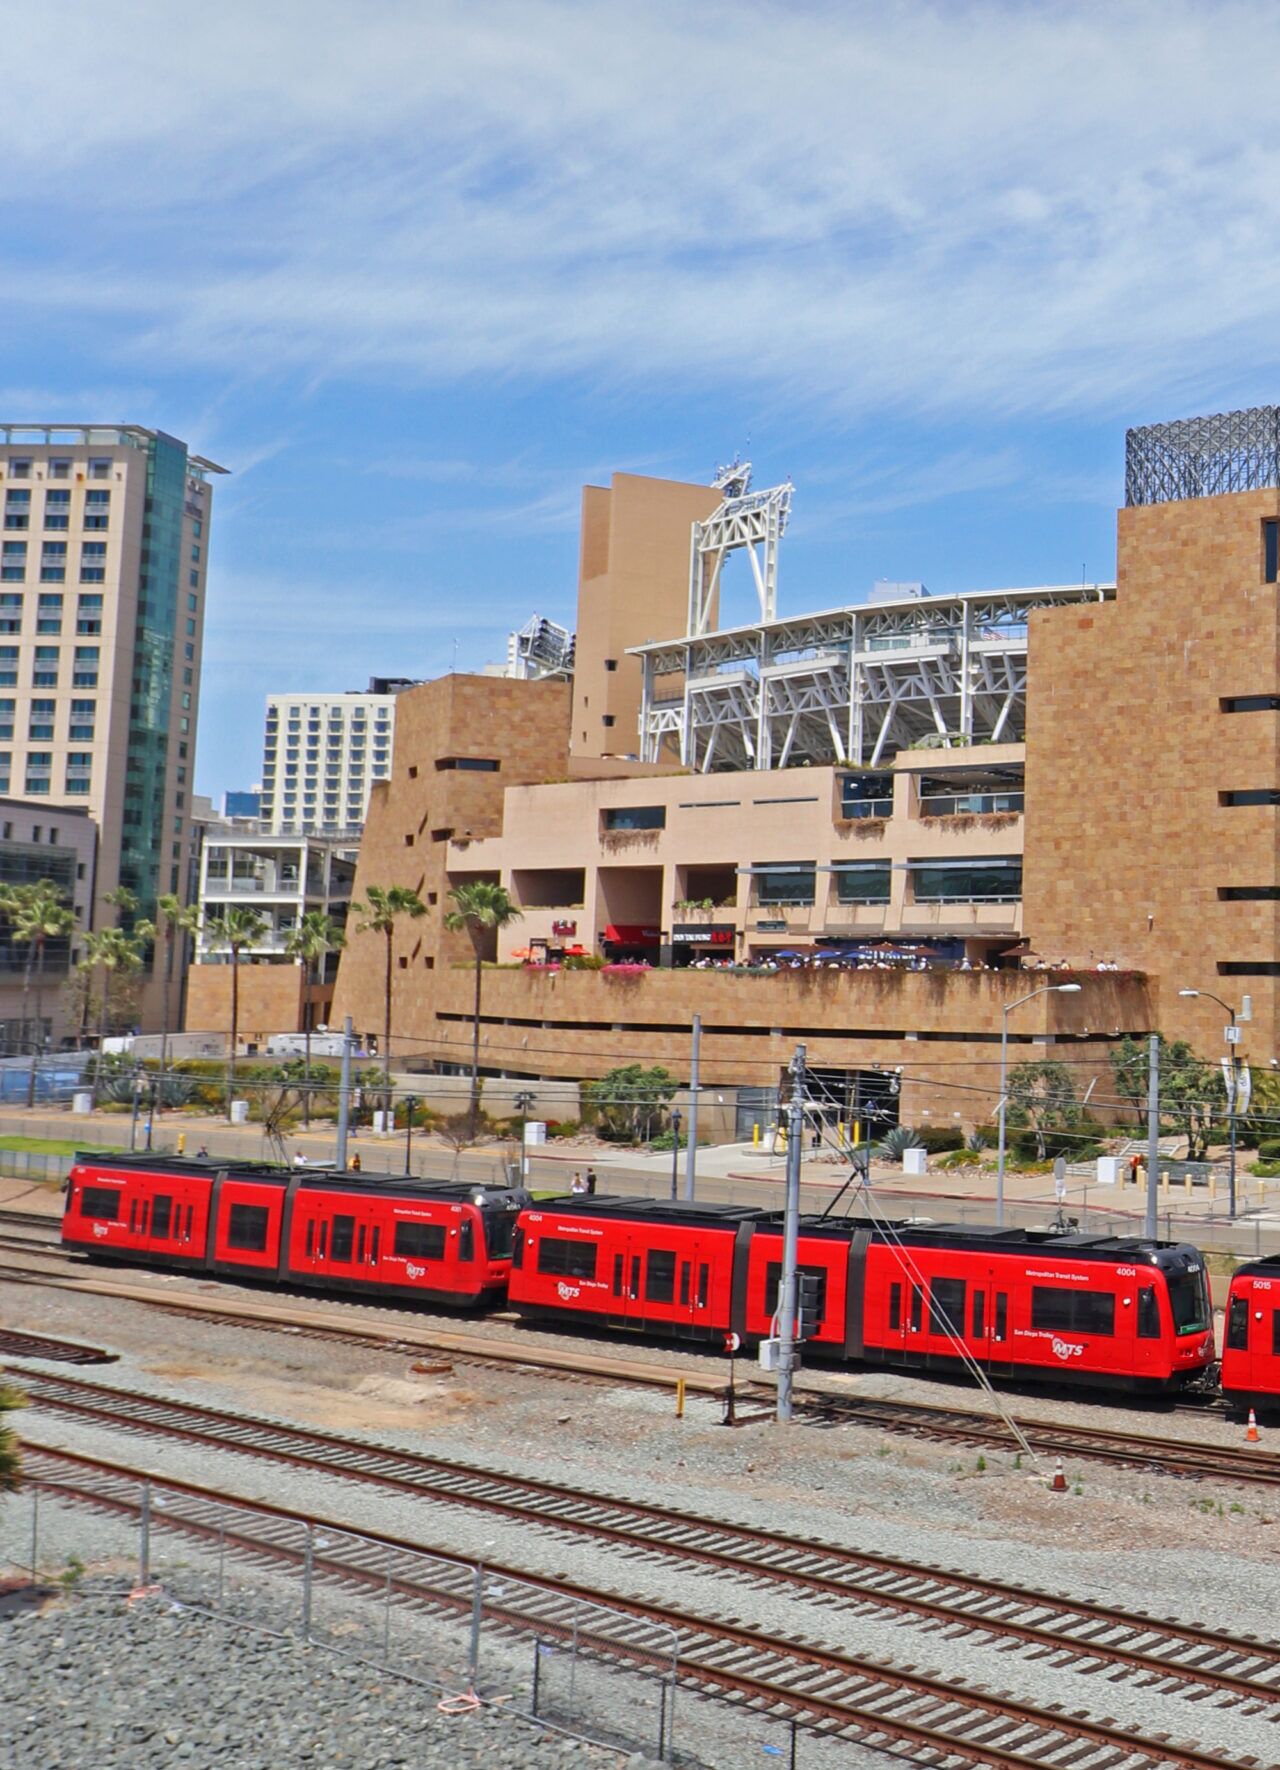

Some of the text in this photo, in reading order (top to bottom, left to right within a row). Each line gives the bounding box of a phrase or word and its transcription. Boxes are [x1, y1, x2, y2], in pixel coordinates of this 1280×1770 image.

[1026, 1270, 1089, 1282] Metropolitan Transit System
[1116, 1267, 1136, 1277] 4004
[1253, 1281, 1271, 1290] 5015
[558, 1286, 580, 1298] MTS
[1024, 1330, 1038, 1338] Diego
[1038, 1331, 1054, 1340] Trolley
[1053, 1342, 1083, 1357] MTS
